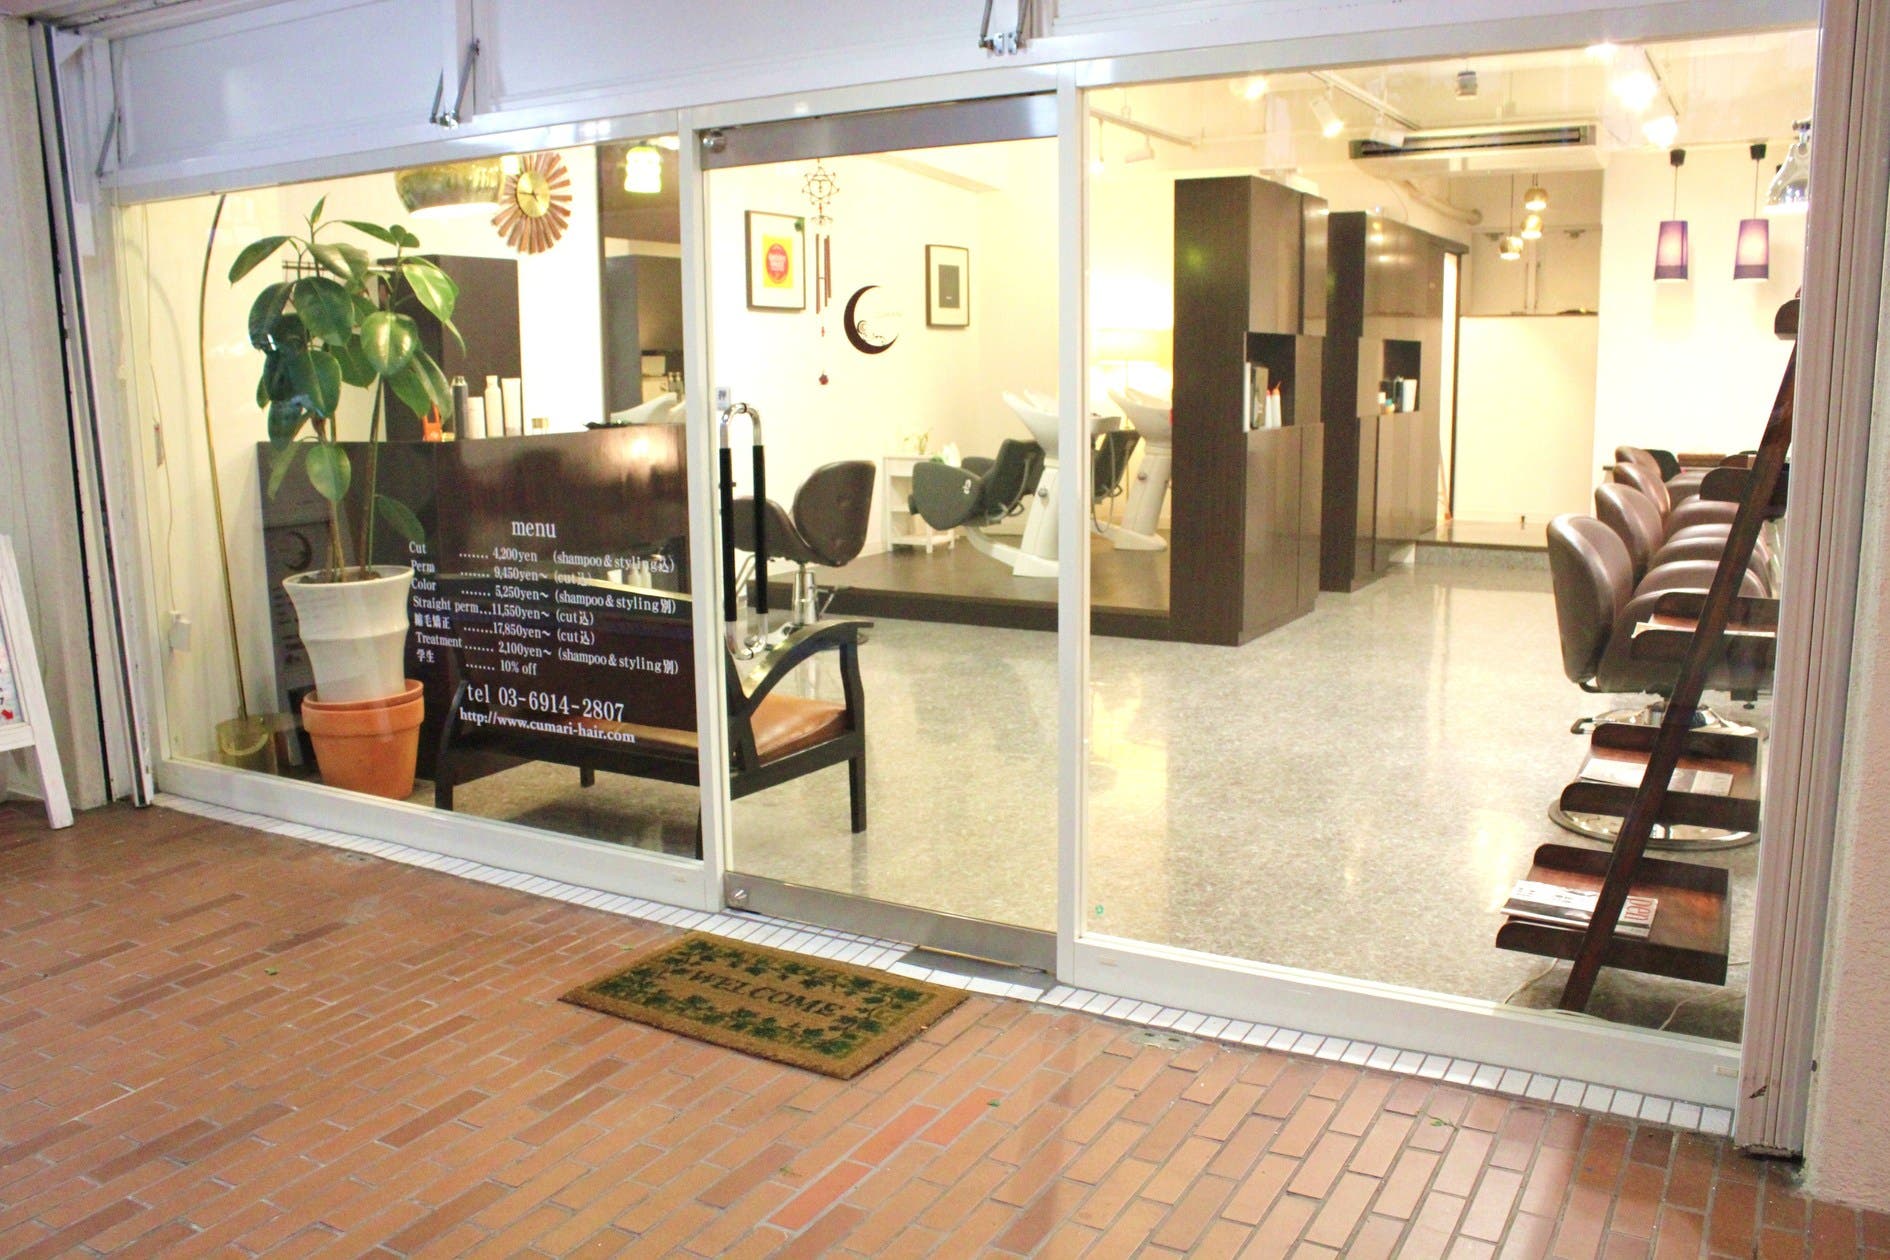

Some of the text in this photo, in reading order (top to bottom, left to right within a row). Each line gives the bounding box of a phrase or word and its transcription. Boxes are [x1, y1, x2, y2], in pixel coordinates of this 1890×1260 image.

[511, 521, 557, 538] menu
[408, 541, 427, 554] Cut
[411, 560, 435, 573] Perm
[411, 578, 437, 591] Color
[413, 596, 451, 611] Straight
[416, 631, 462, 648] Treatment
[500, 660, 519, 673] 10%
[522, 663, 537, 675] off
[467, 684, 625, 722] tel 03-6914-2807
[459, 707, 636, 743] http://www.cumari-hair.com
[688, 970, 846, 1016] WELCOME
